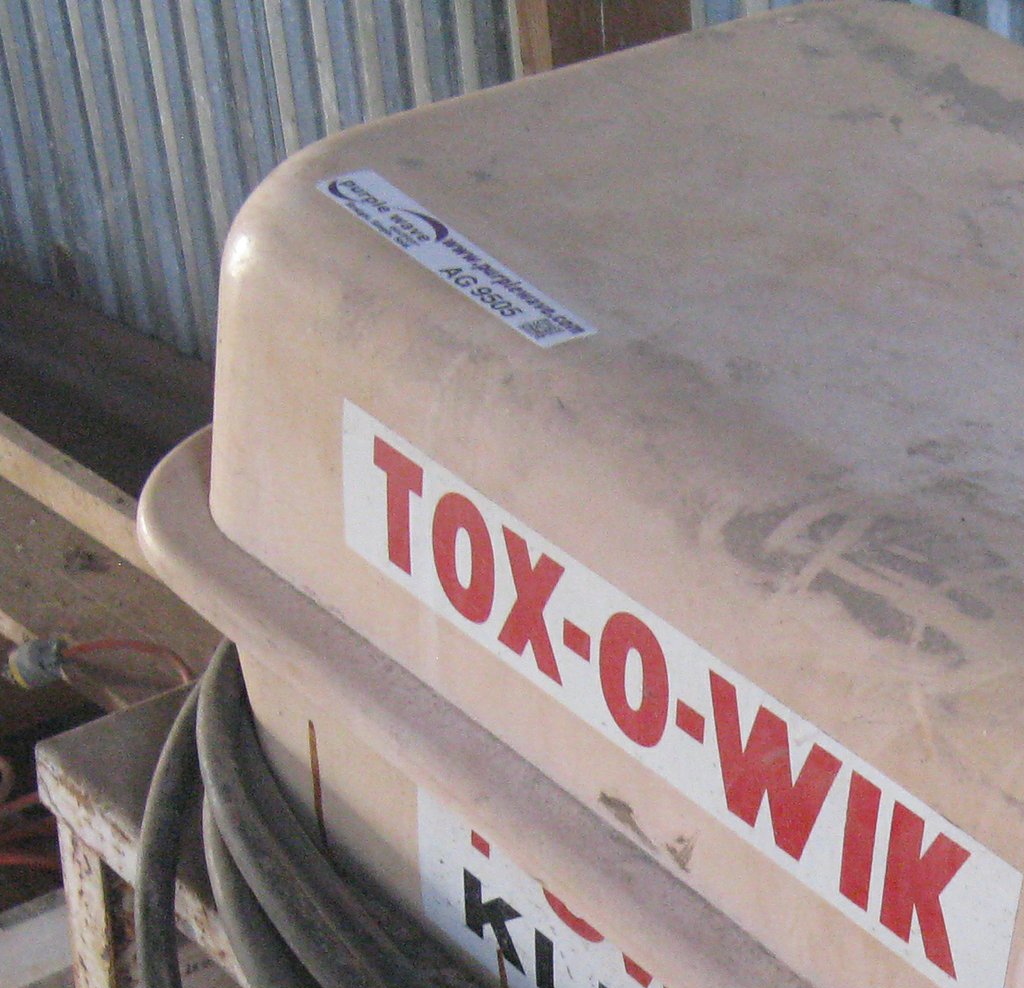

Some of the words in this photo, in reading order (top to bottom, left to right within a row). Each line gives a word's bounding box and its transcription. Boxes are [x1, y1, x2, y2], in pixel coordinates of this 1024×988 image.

[339, 180, 390, 213] purple
[390, 214, 430, 242] wave
[439, 266, 478, 289] AG
[471, 287, 523, 318] 9505
[442, 238, 585, 334] www.purplewave.com
[373, 435, 971, 982] TOX-O-WIK
